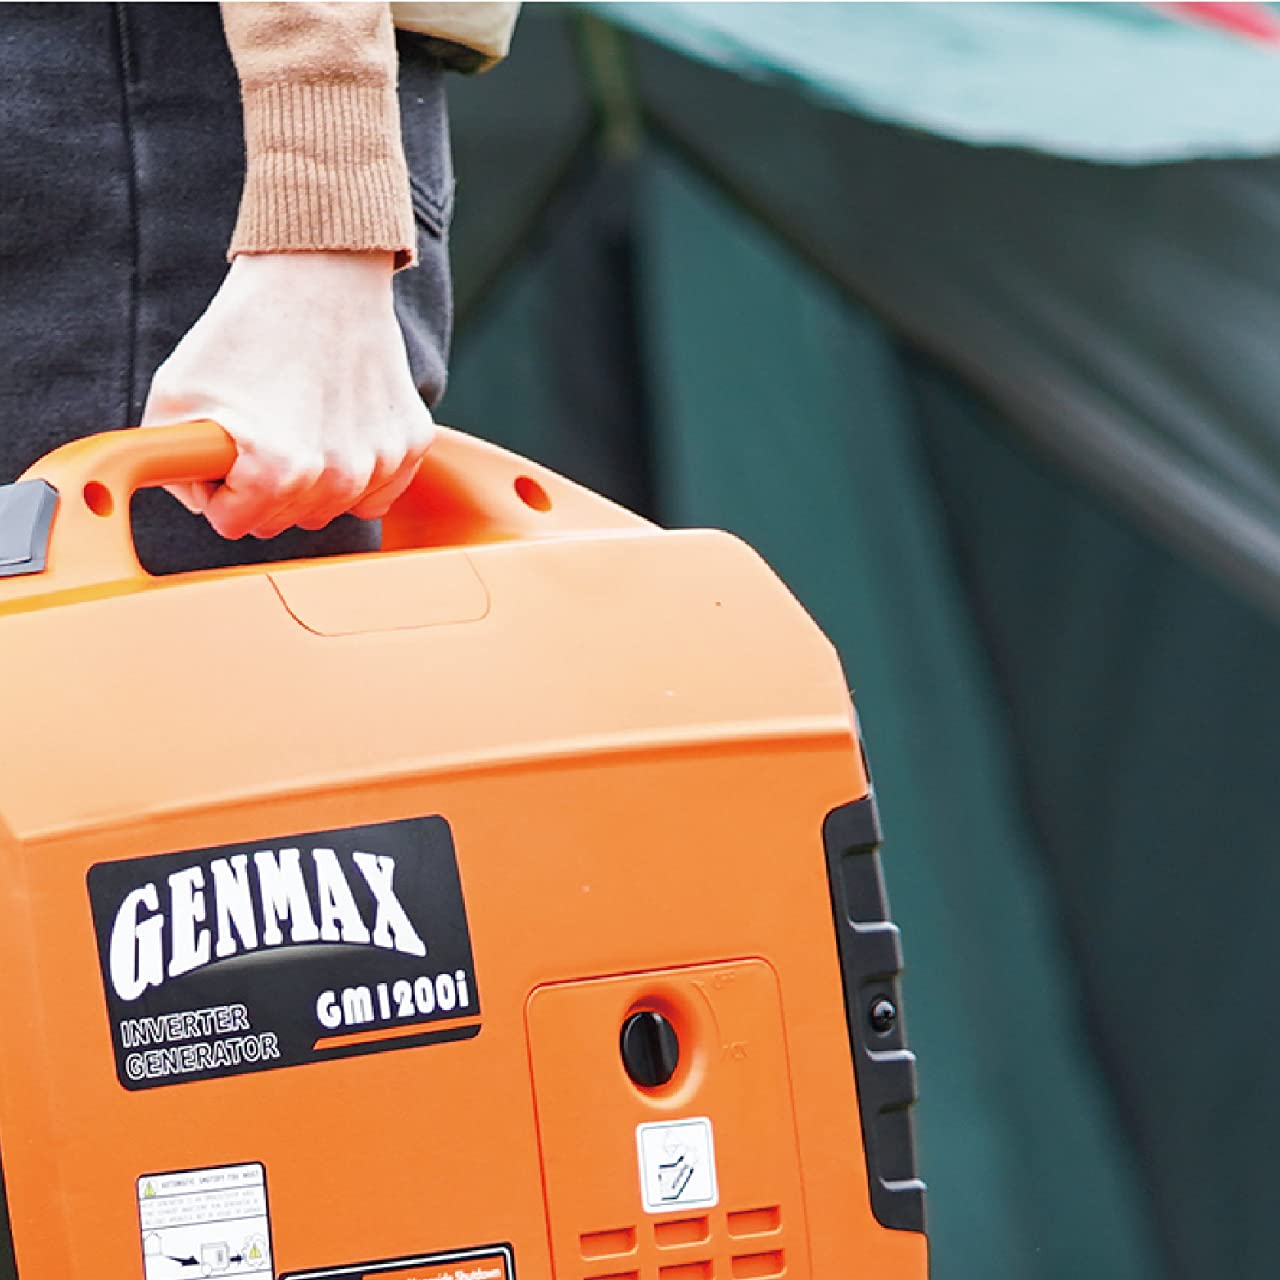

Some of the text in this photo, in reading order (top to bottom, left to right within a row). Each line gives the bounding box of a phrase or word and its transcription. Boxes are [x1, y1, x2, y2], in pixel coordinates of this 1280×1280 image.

[109, 848, 426, 1001] GENMAX
[120, 1004, 250, 1048] INVERTER
[316, 969, 469, 1029] GM1200i
[125, 1032, 280, 1080] GENERATOR
